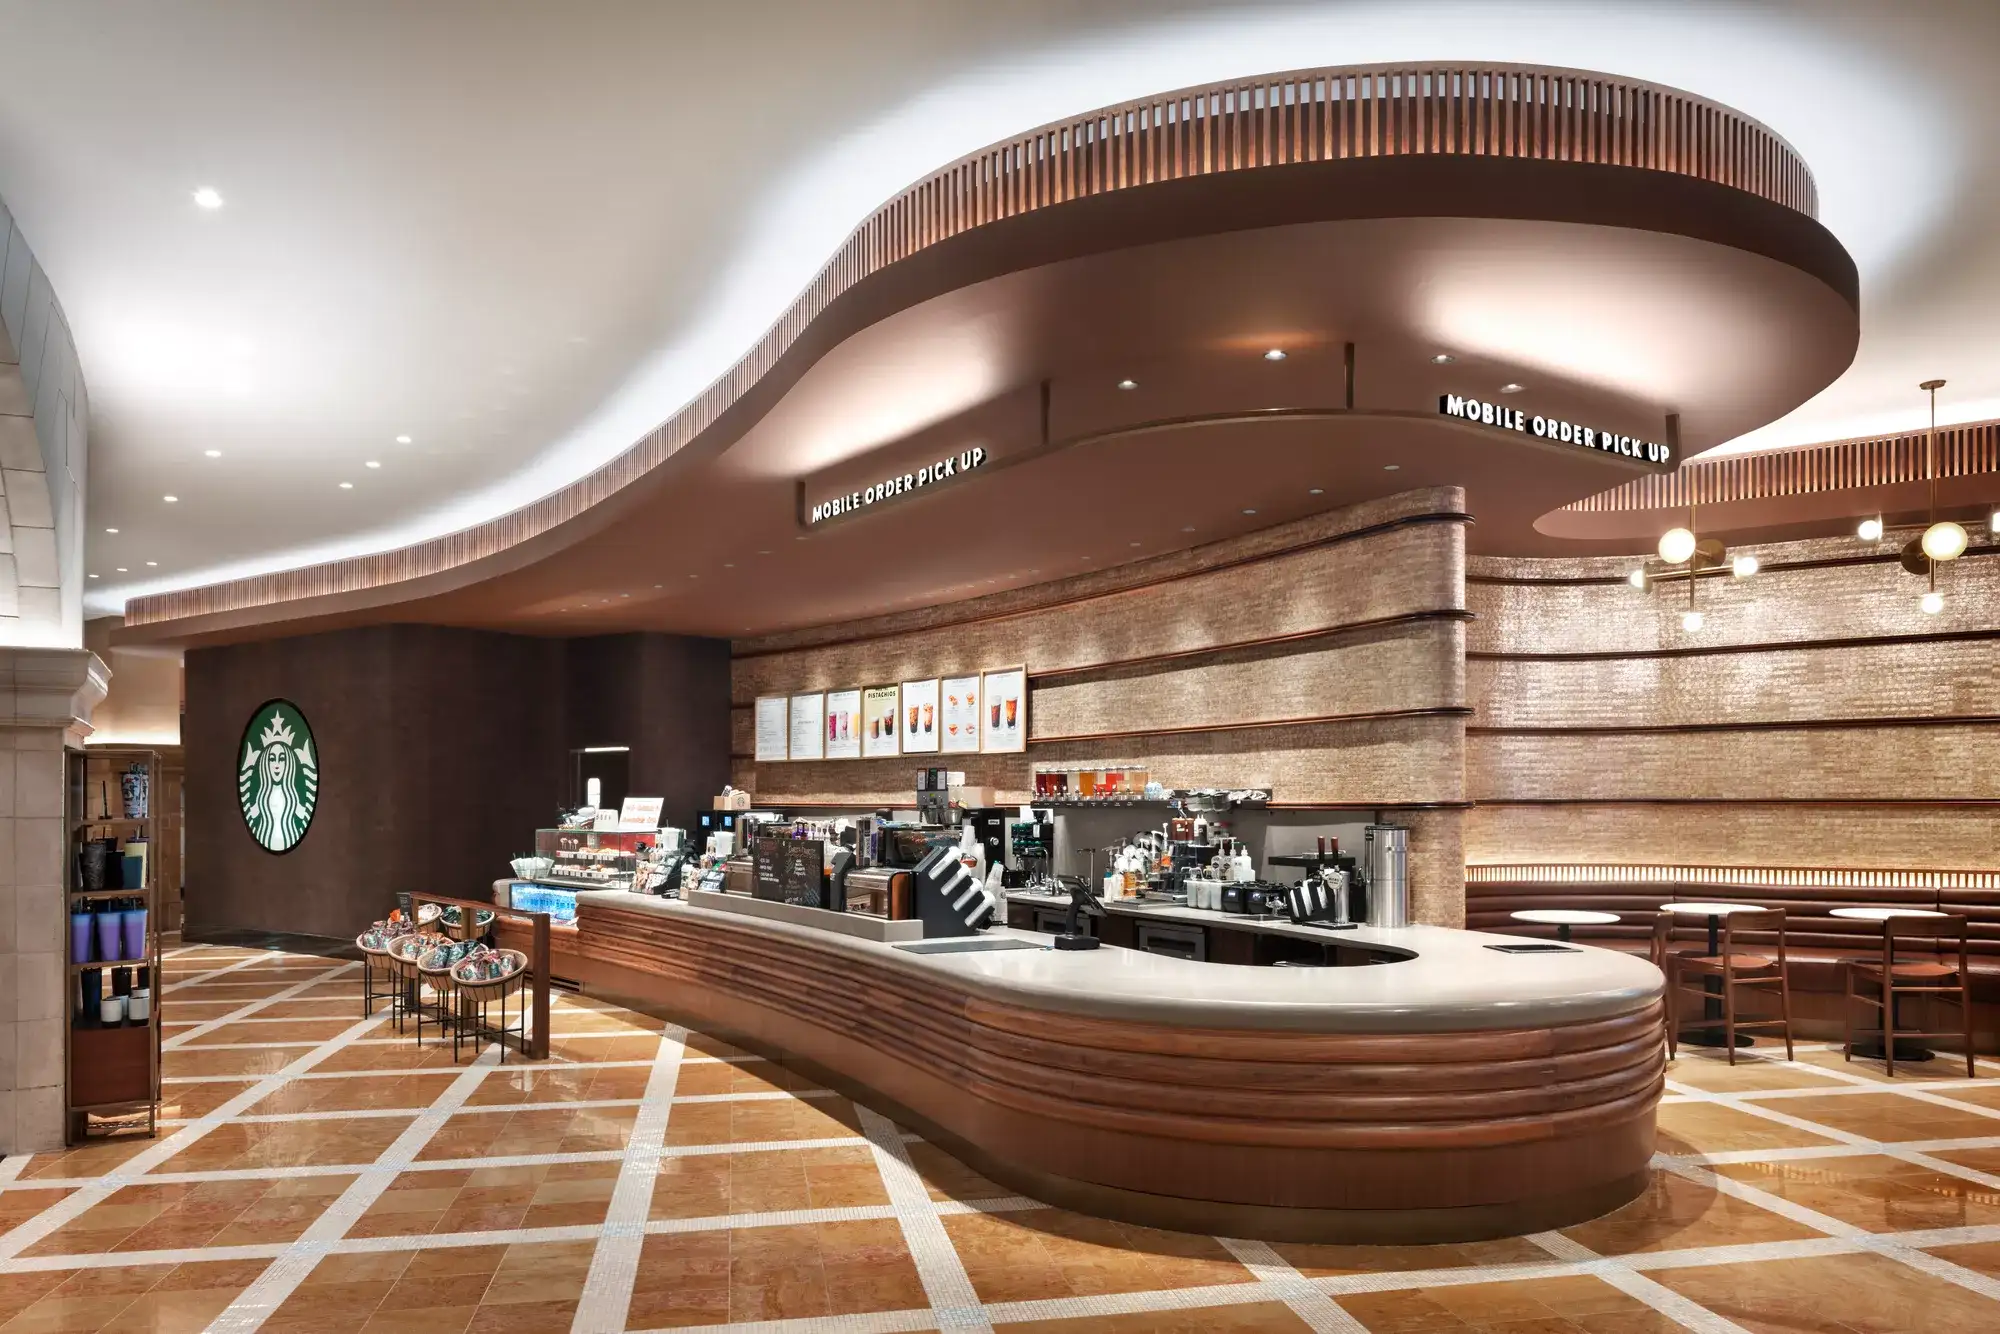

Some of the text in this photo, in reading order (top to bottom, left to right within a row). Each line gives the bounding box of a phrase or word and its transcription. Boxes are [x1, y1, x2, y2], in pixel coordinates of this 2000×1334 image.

[1446, 393, 1671, 464] MOBILE ORDER PICK UP
[811, 446, 984, 523] MOBILE ORDER PICK UP
[867, 690, 897, 699] PISTACHIOS
